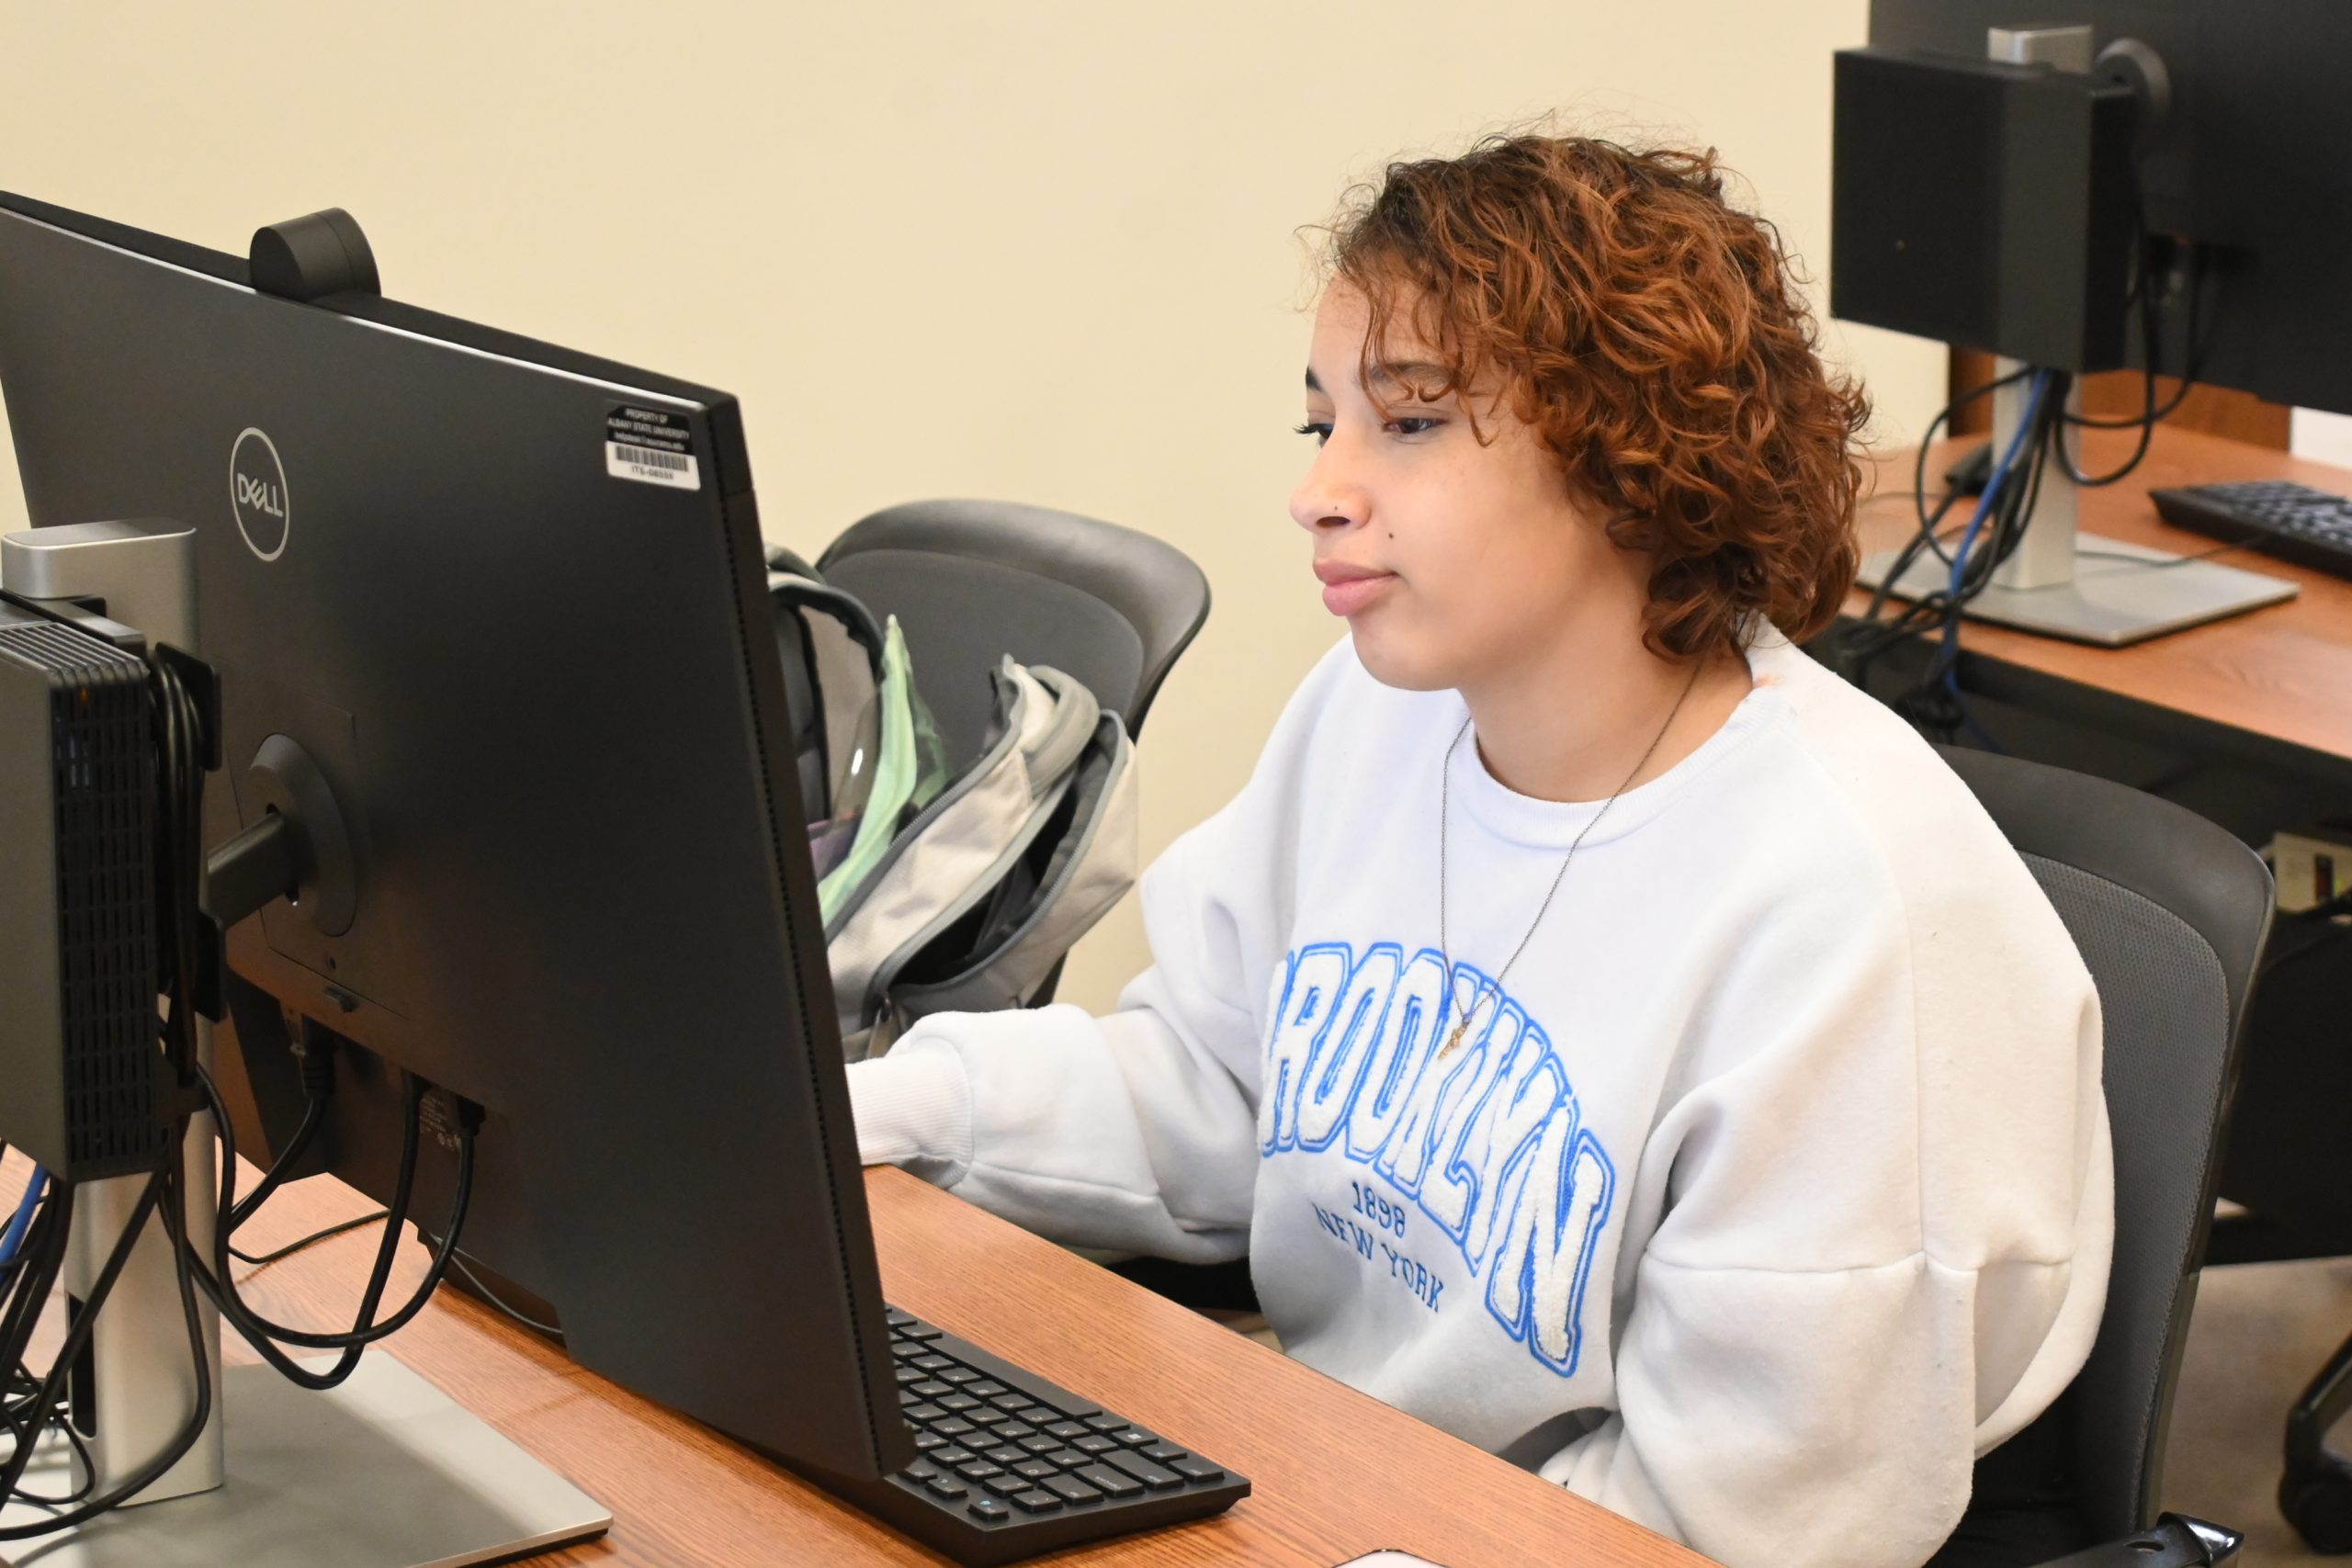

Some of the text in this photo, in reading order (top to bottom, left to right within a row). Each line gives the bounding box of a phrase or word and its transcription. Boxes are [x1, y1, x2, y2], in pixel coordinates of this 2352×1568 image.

[626, 408, 668, 423] PROPERTY OF
[653, 425, 690, 440] UNIVERSITY
[237, 472, 284, 518] DELL
[1261, 942, 1616, 1378] ROOKLYN
[1351, 1180, 1406, 1239] 1898
[1310, 1201, 1444, 1314] NEW YORK
